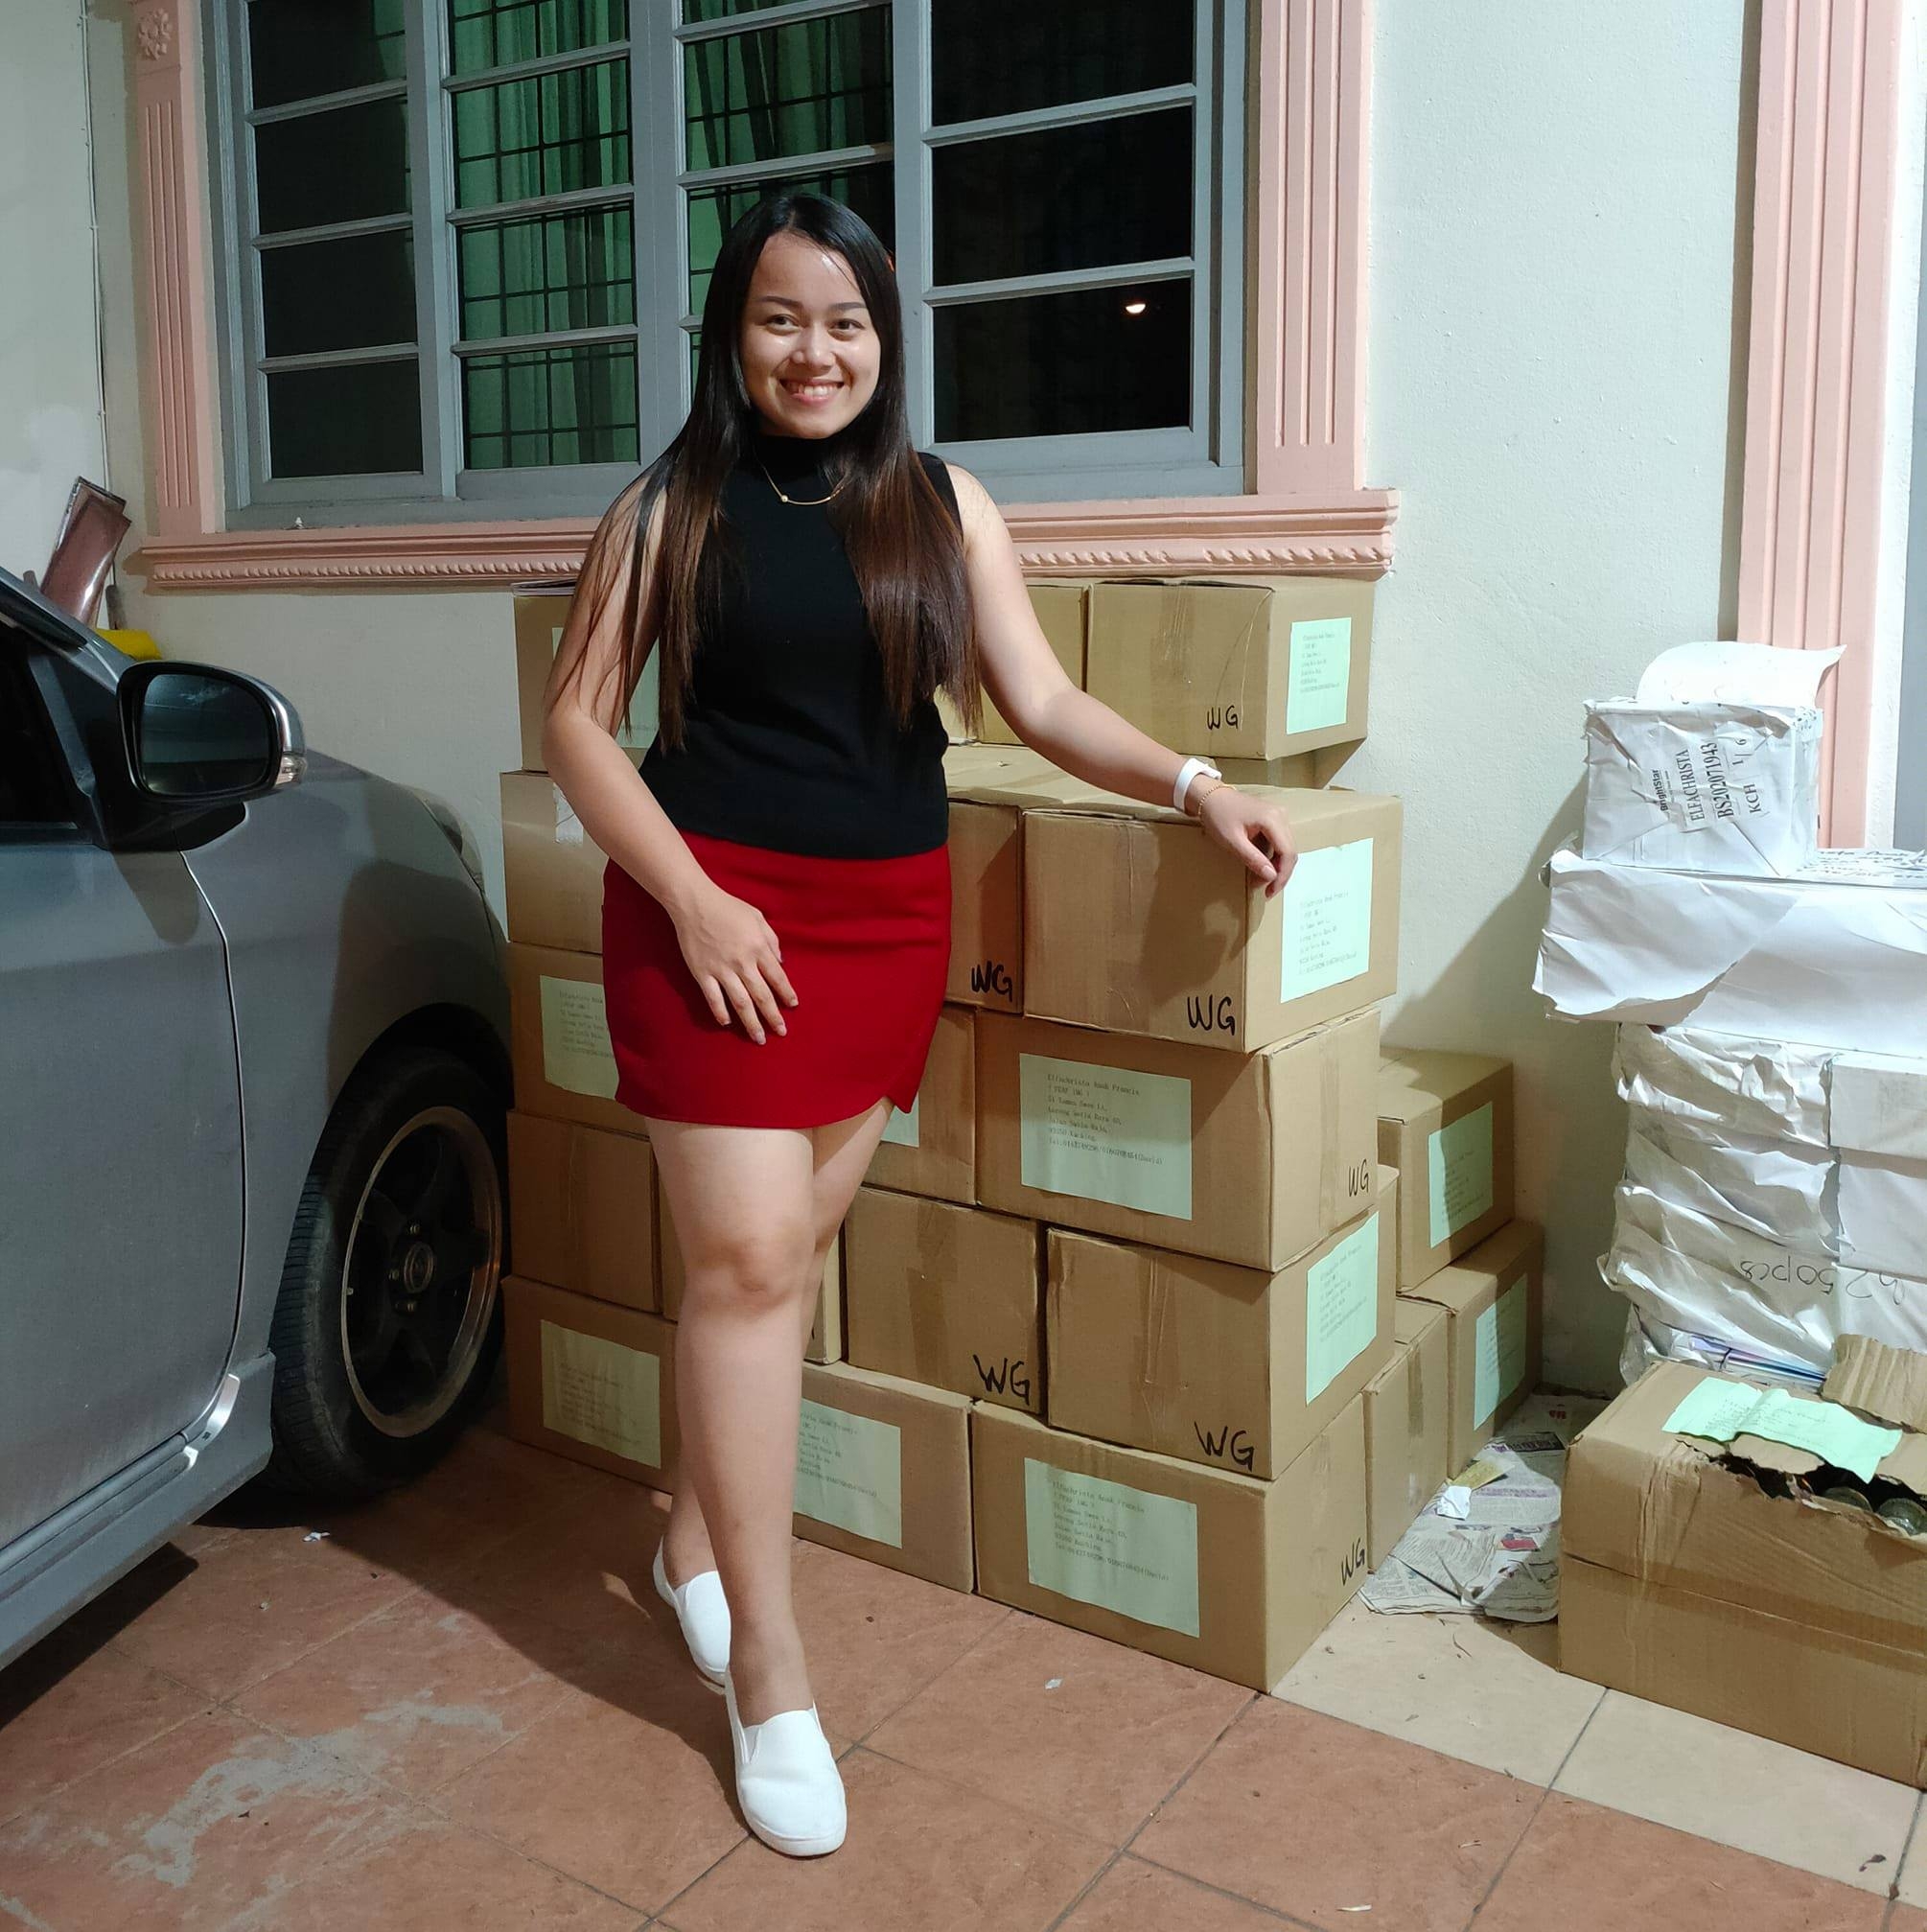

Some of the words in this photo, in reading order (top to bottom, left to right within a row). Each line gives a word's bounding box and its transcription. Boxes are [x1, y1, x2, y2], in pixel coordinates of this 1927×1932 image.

[1206, 705, 1239, 731] WG
[1652, 769, 1668, 811] BrightStar
[1676, 749, 1706, 822] ELFACHRISTA
[1743, 783, 1762, 814] KCH
[971, 960, 1013, 1003] WG
[1187, 993, 1237, 1036] WG
[1348, 1158, 1369, 1198] WG
[973, 1354, 1032, 1407] WG
[1194, 1421, 1256, 1472] WG
[1341, 1537, 1366, 1586] WG
